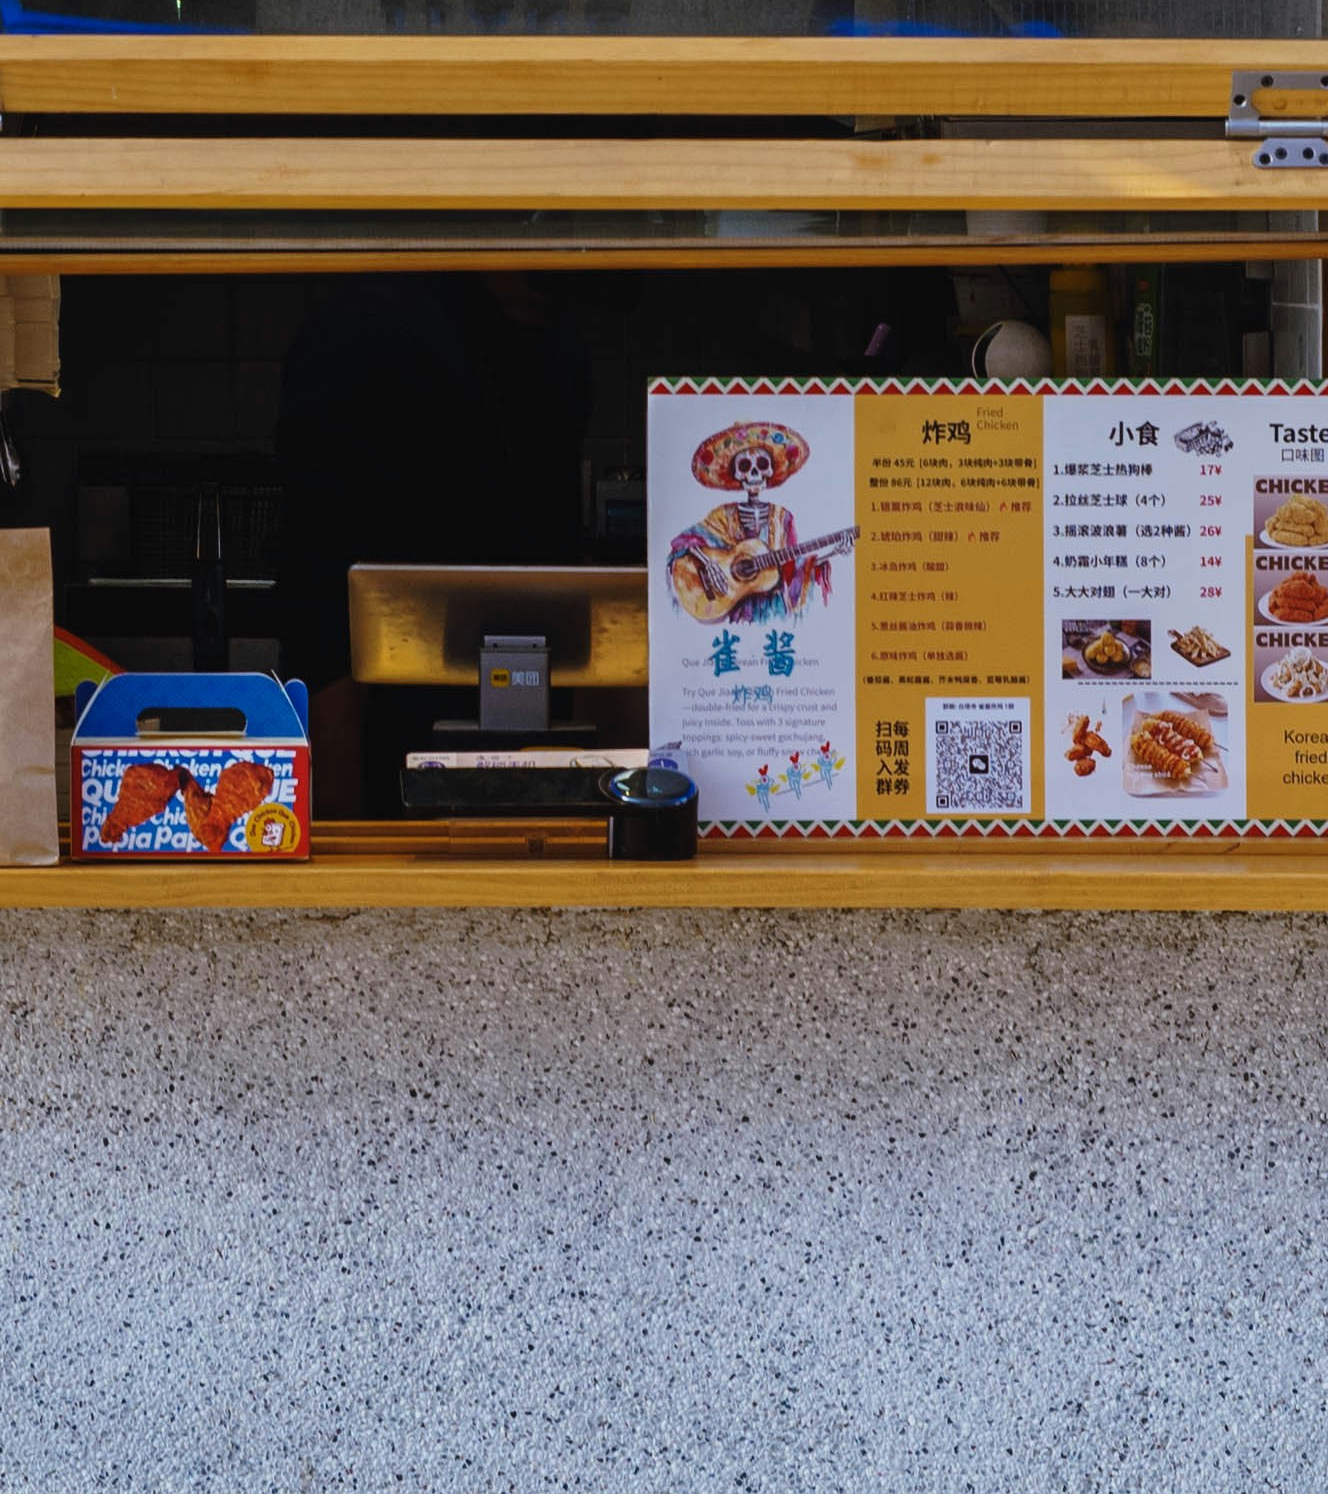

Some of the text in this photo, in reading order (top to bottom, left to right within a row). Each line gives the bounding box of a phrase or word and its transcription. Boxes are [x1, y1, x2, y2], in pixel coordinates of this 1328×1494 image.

[976, 407, 1004, 418] Fried
[922, 420, 972, 445] 炸鸡
[976, 420, 1020, 431] Chicken
[1108, 421, 1160, 447] 小食
[1281, 448, 1325, 462] 口味图
[682, 658, 700, 668] Que
[511, 670, 540, 686] 美团
[682, 688, 697, 699] Try
[698, 688, 716, 698] Que
[776, 687, 797, 697] Fried
[800, 687, 835, 697] Chicken
[1295, 749, 1327, 764] fried
[82, 778, 121, 807] QU
